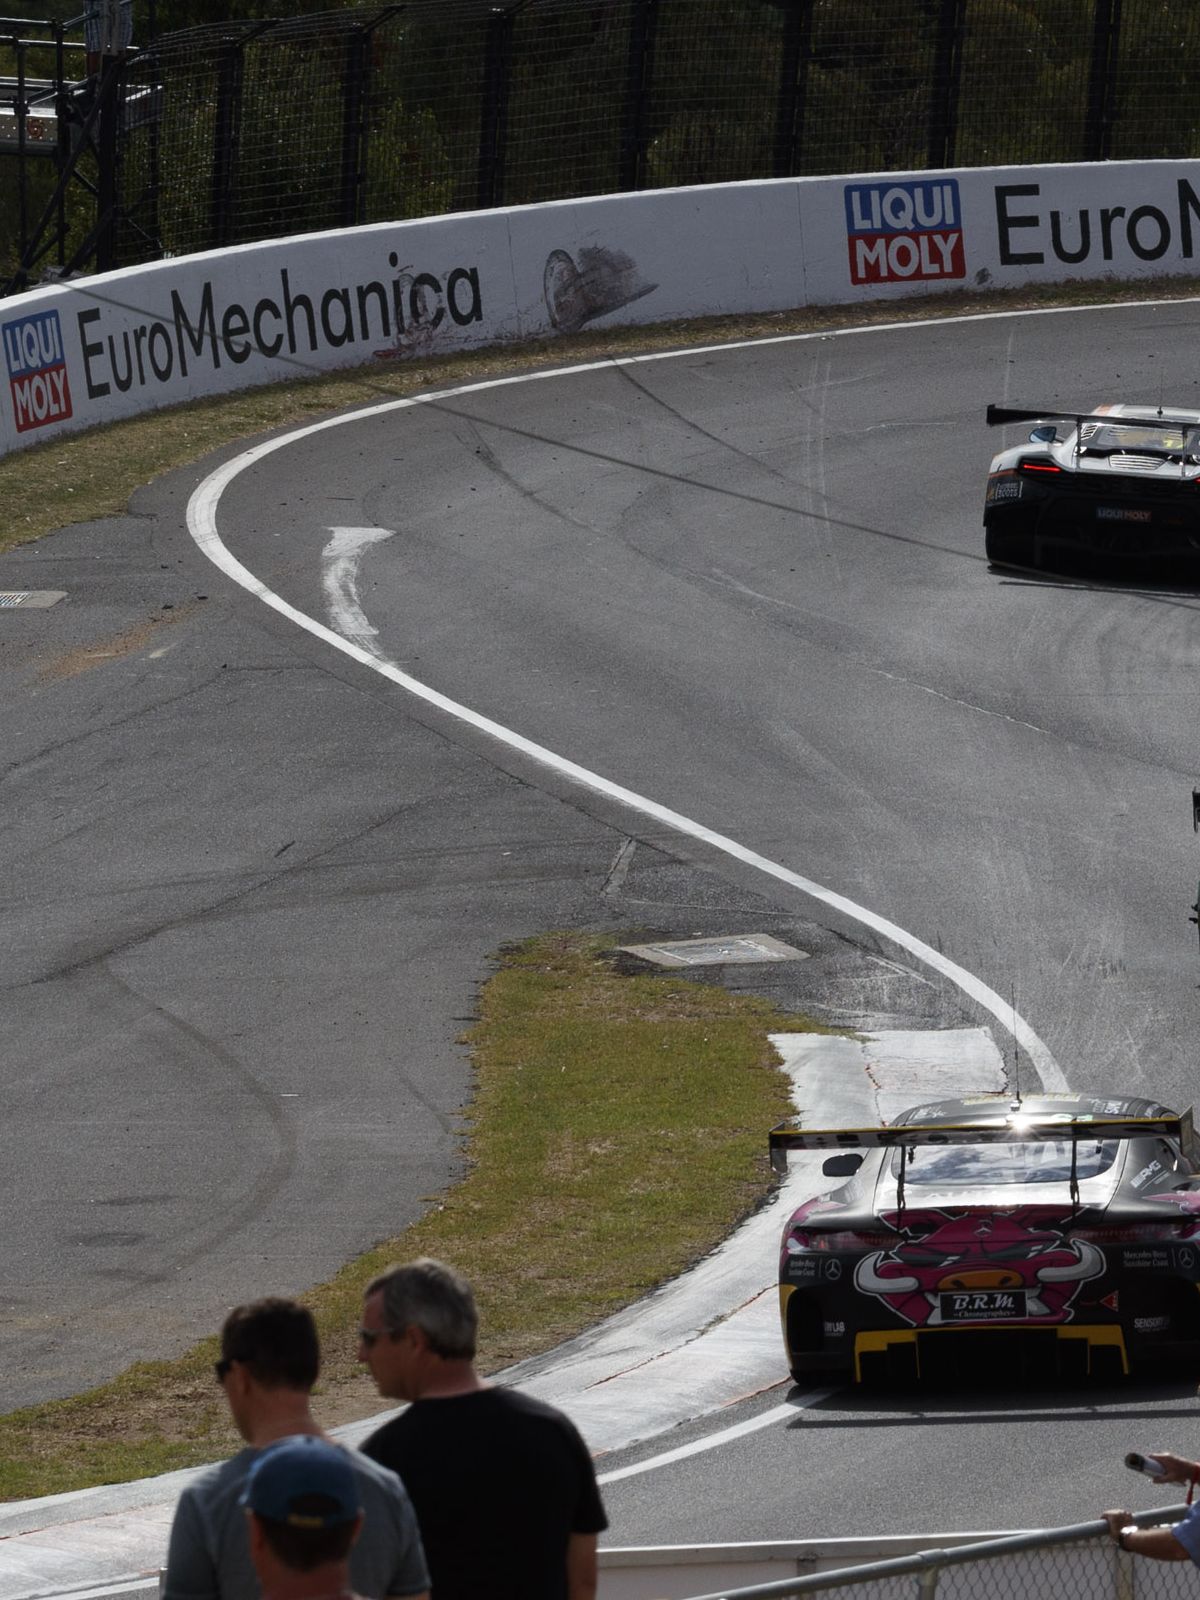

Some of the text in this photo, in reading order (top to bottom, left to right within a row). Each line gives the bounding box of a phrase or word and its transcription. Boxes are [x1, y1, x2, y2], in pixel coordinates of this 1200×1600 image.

[851, 185, 955, 230] LIQUI
[855, 233, 959, 278] MOLY
[6, 317, 61, 372] LIQUI
[77, 251, 483, 399] EuroMechanica
[14, 369, 66, 425] MOLY
